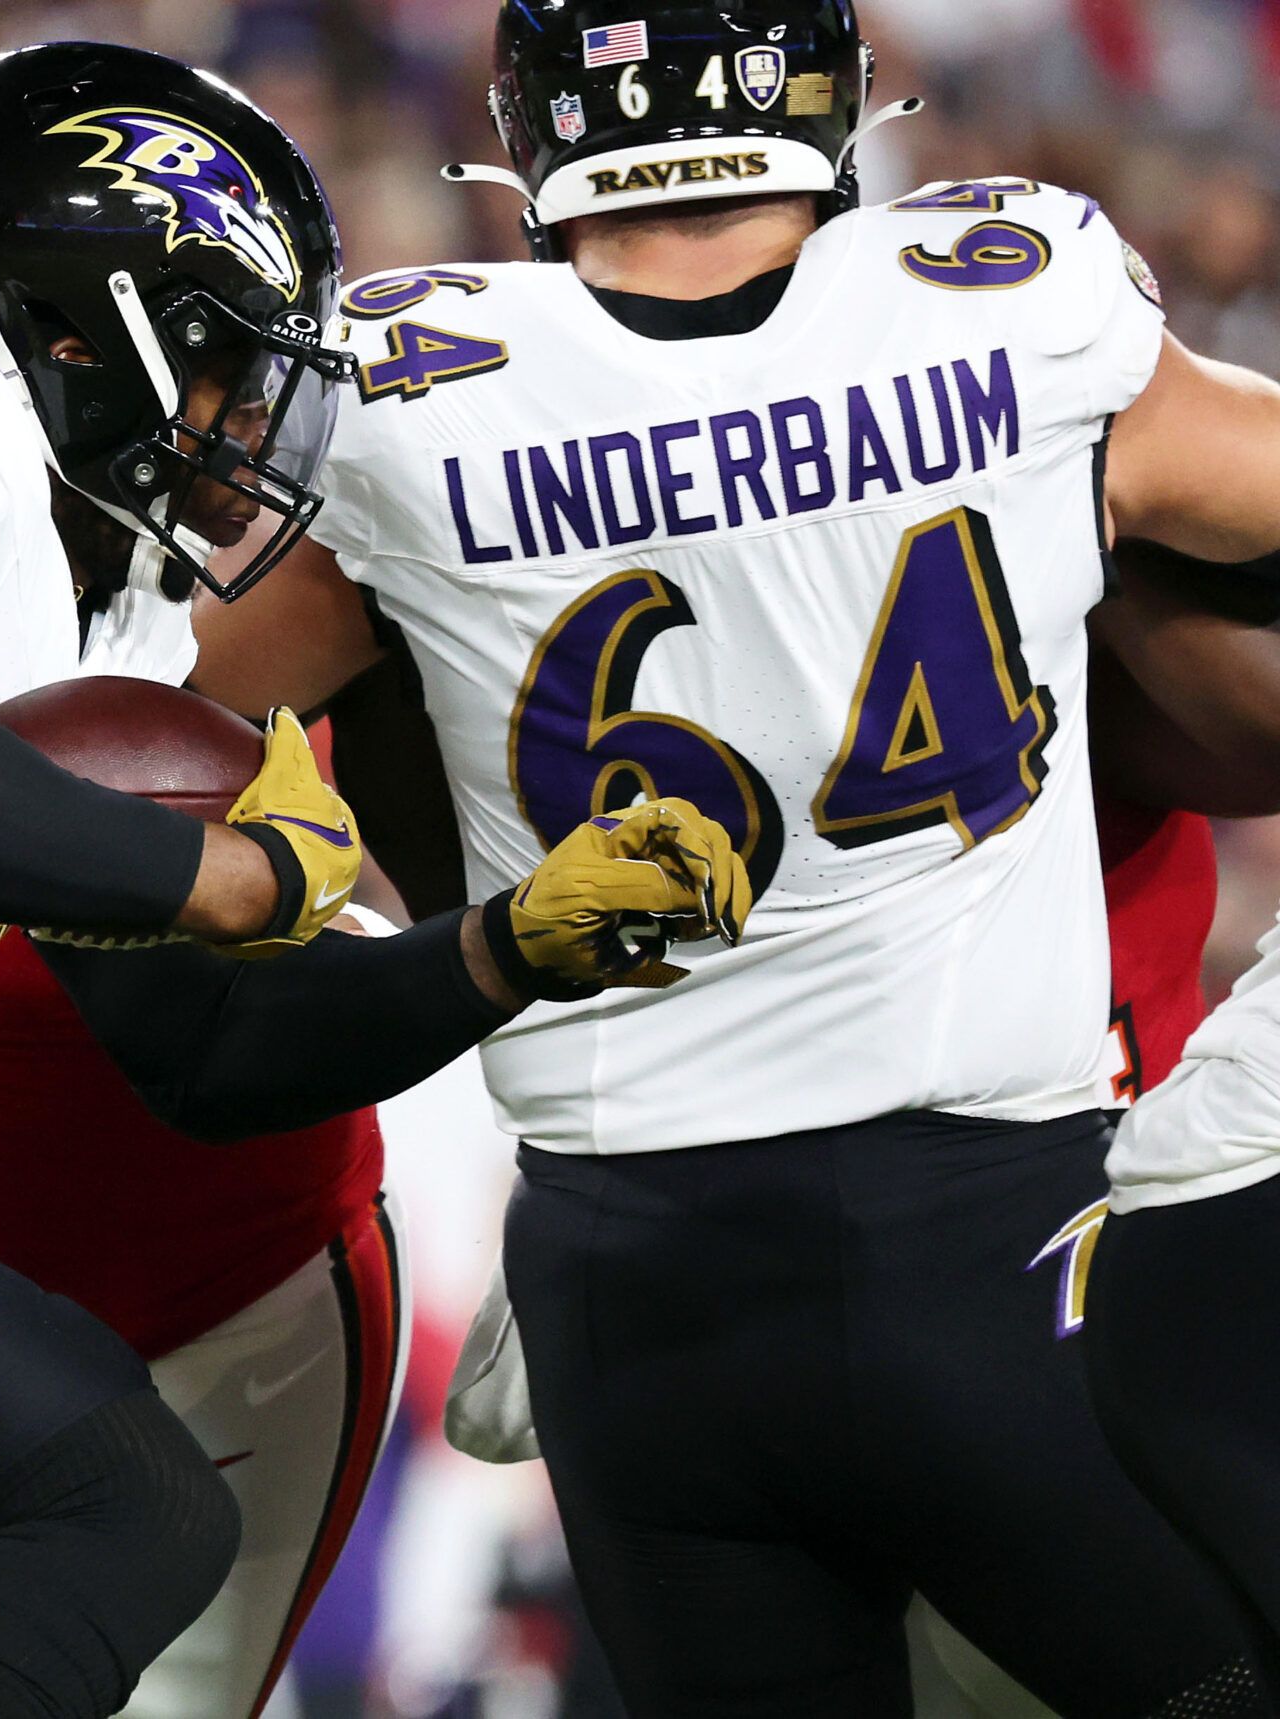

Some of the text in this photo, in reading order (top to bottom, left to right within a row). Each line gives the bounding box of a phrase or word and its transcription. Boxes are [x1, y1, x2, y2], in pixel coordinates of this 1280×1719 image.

[618, 64, 650, 119] 6
[695, 55, 728, 109] 4
[120, 120, 216, 178] B
[586, 151, 770, 196] RAVENS
[271, 323, 320, 346] OAKLEY
[339, 270, 510, 404] 64
[443, 347, 1021, 565] LINDERBAUM
[507, 505, 1058, 905] 64
